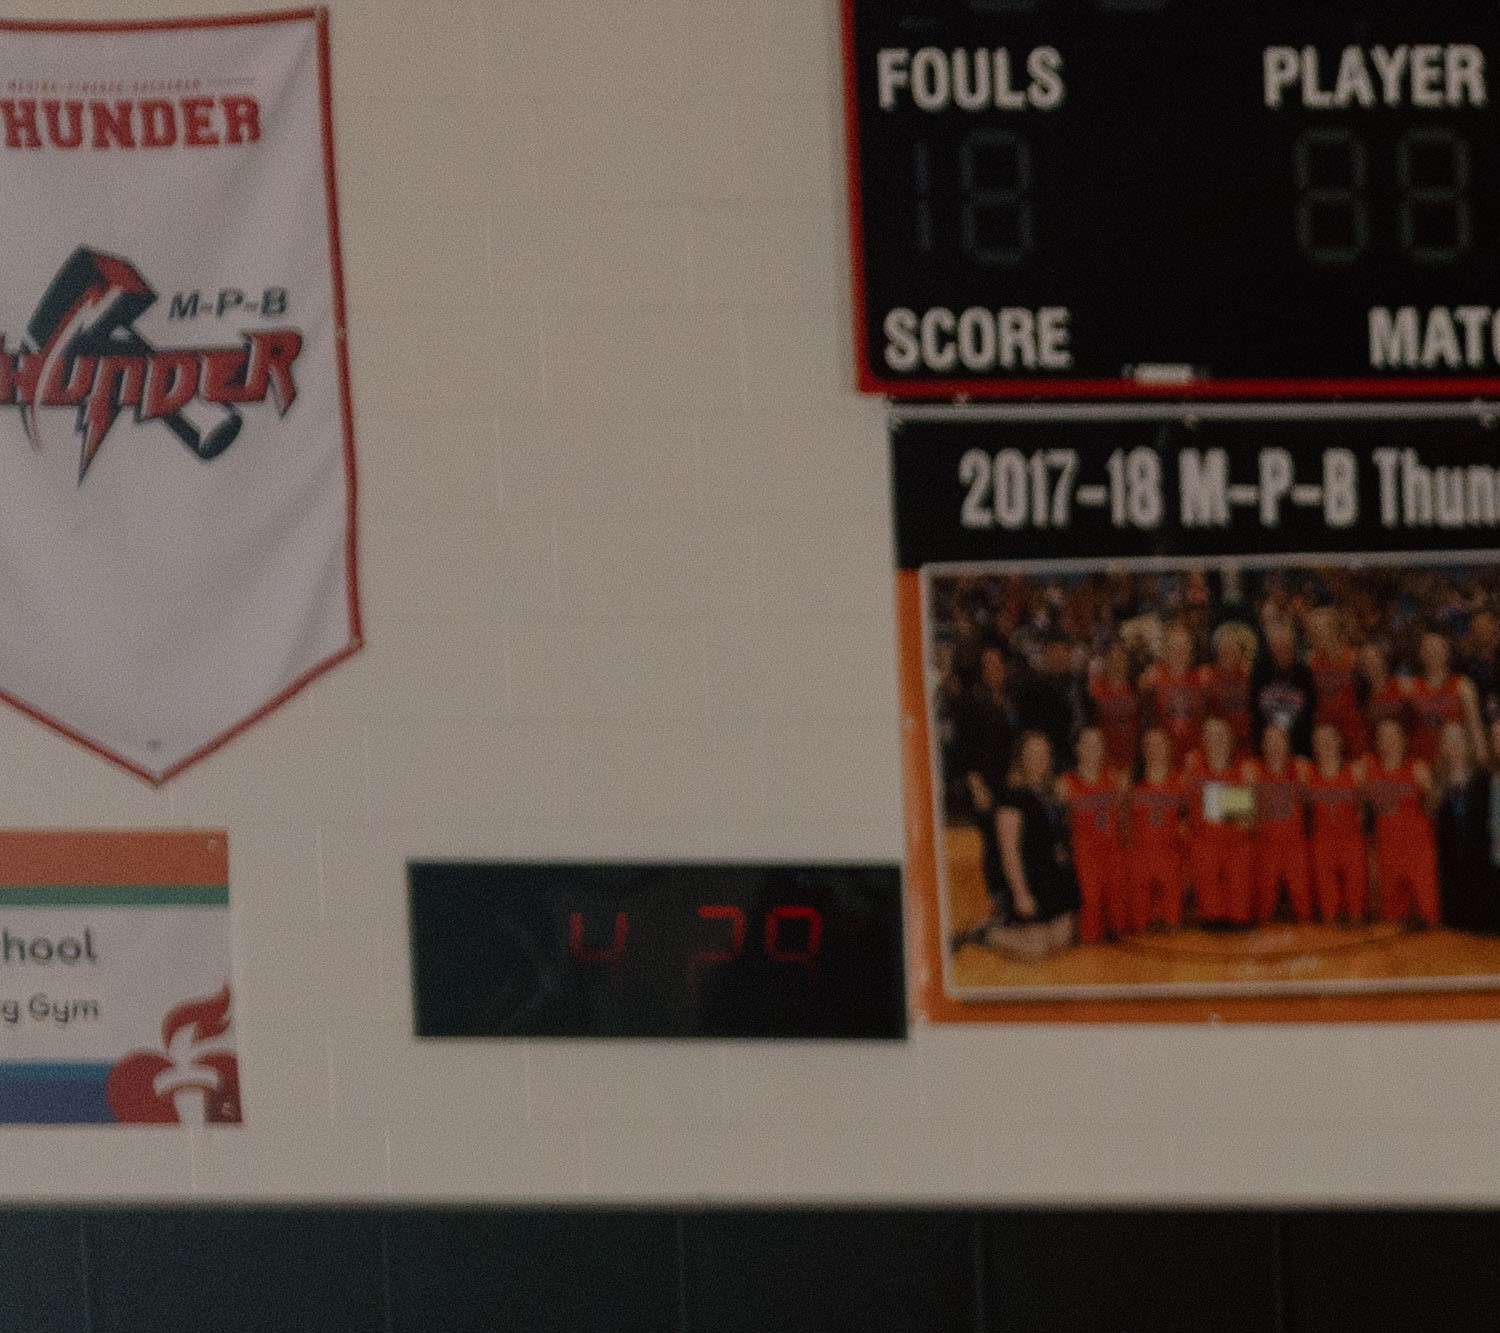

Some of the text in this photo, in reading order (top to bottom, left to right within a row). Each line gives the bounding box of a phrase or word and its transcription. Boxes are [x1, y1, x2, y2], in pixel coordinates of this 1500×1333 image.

[876, 45, 1066, 110] FOULS
[1262, 43, 1488, 108] PLAYER
[0, 95, 262, 150] HUNDER
[168, 286, 289, 323] M-P-B
[882, 305, 1074, 372] SCORE
[0, 328, 303, 485] HUNDER
[957, 446, 1163, 529] 2017-18
[1178, 445, 1358, 529] M-P-B
[2, 926, 98, 964] hool
[28, 991, 99, 1025] Gym
